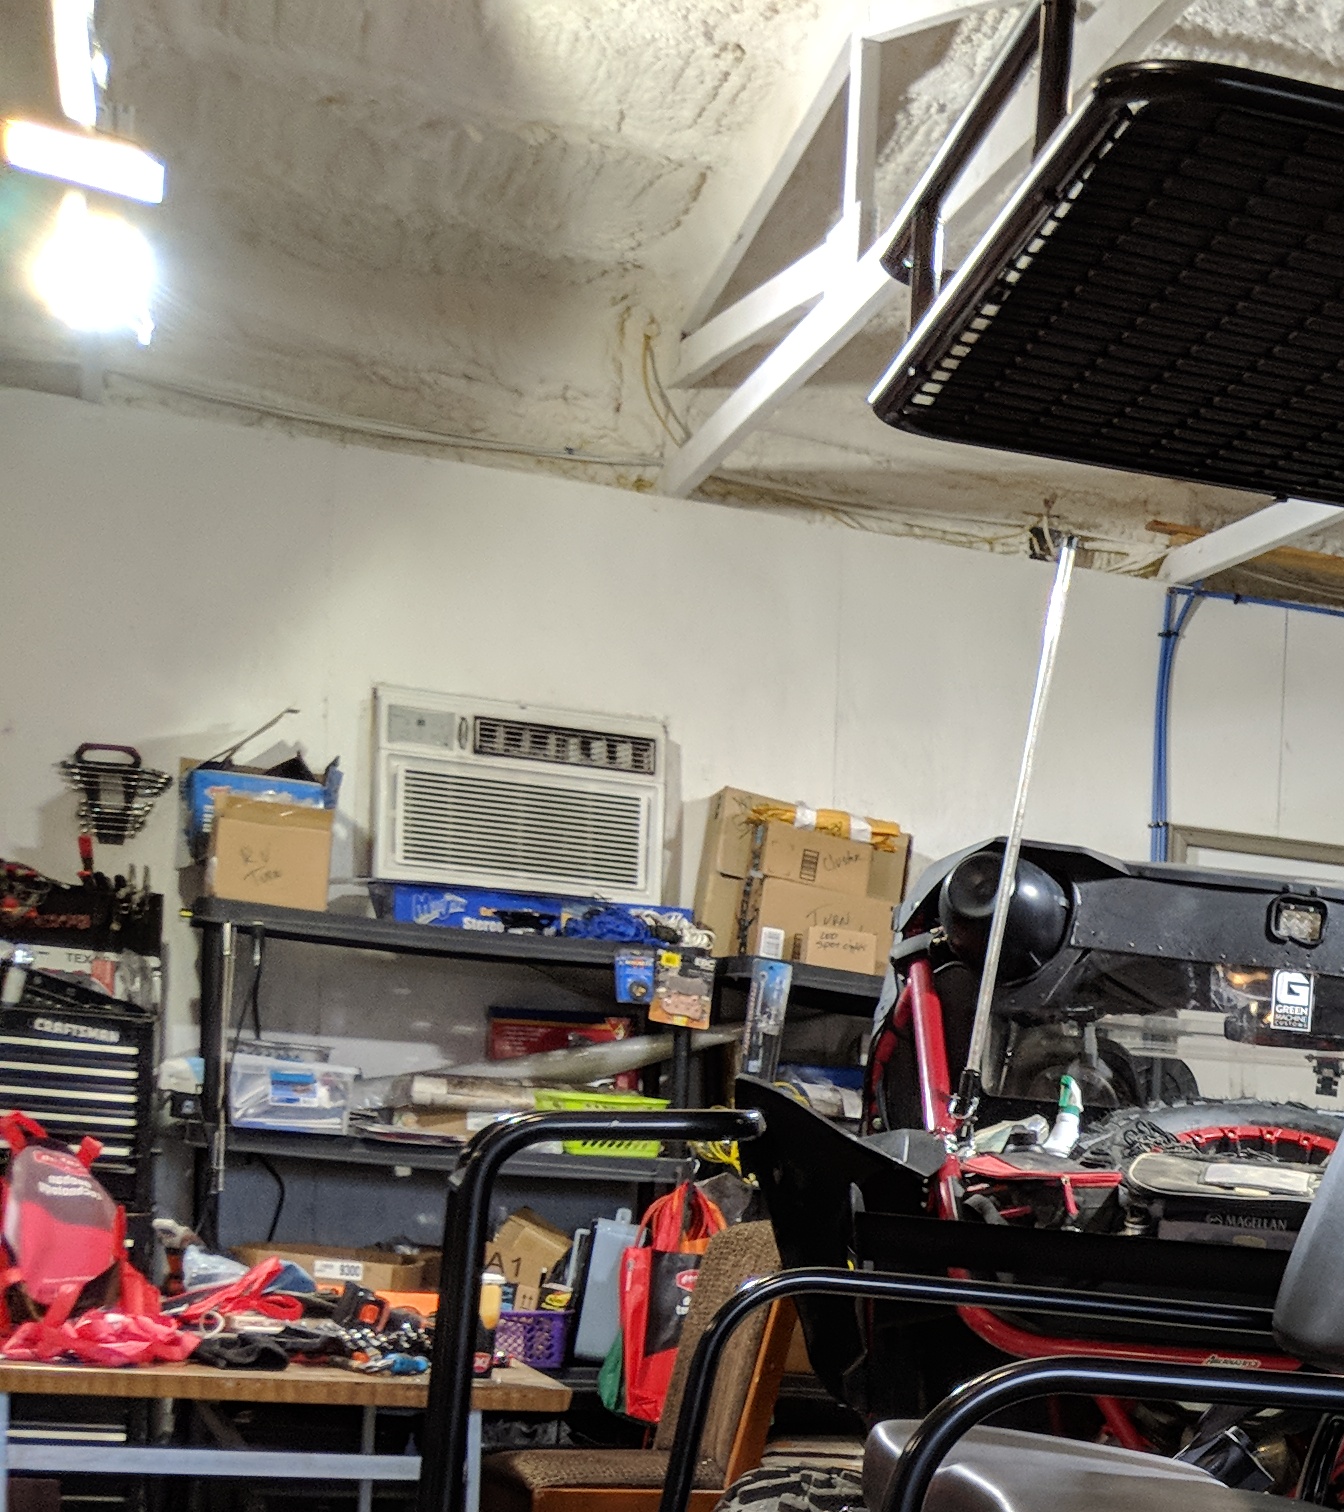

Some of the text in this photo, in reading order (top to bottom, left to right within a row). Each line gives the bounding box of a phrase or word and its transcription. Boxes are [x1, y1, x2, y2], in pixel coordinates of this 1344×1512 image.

[1275, 1003, 1309, 1016] GREEN
[33, 1017, 121, 1043] CRAFTSMAN
[1224, 1214, 1288, 1231] MAGELLAN
